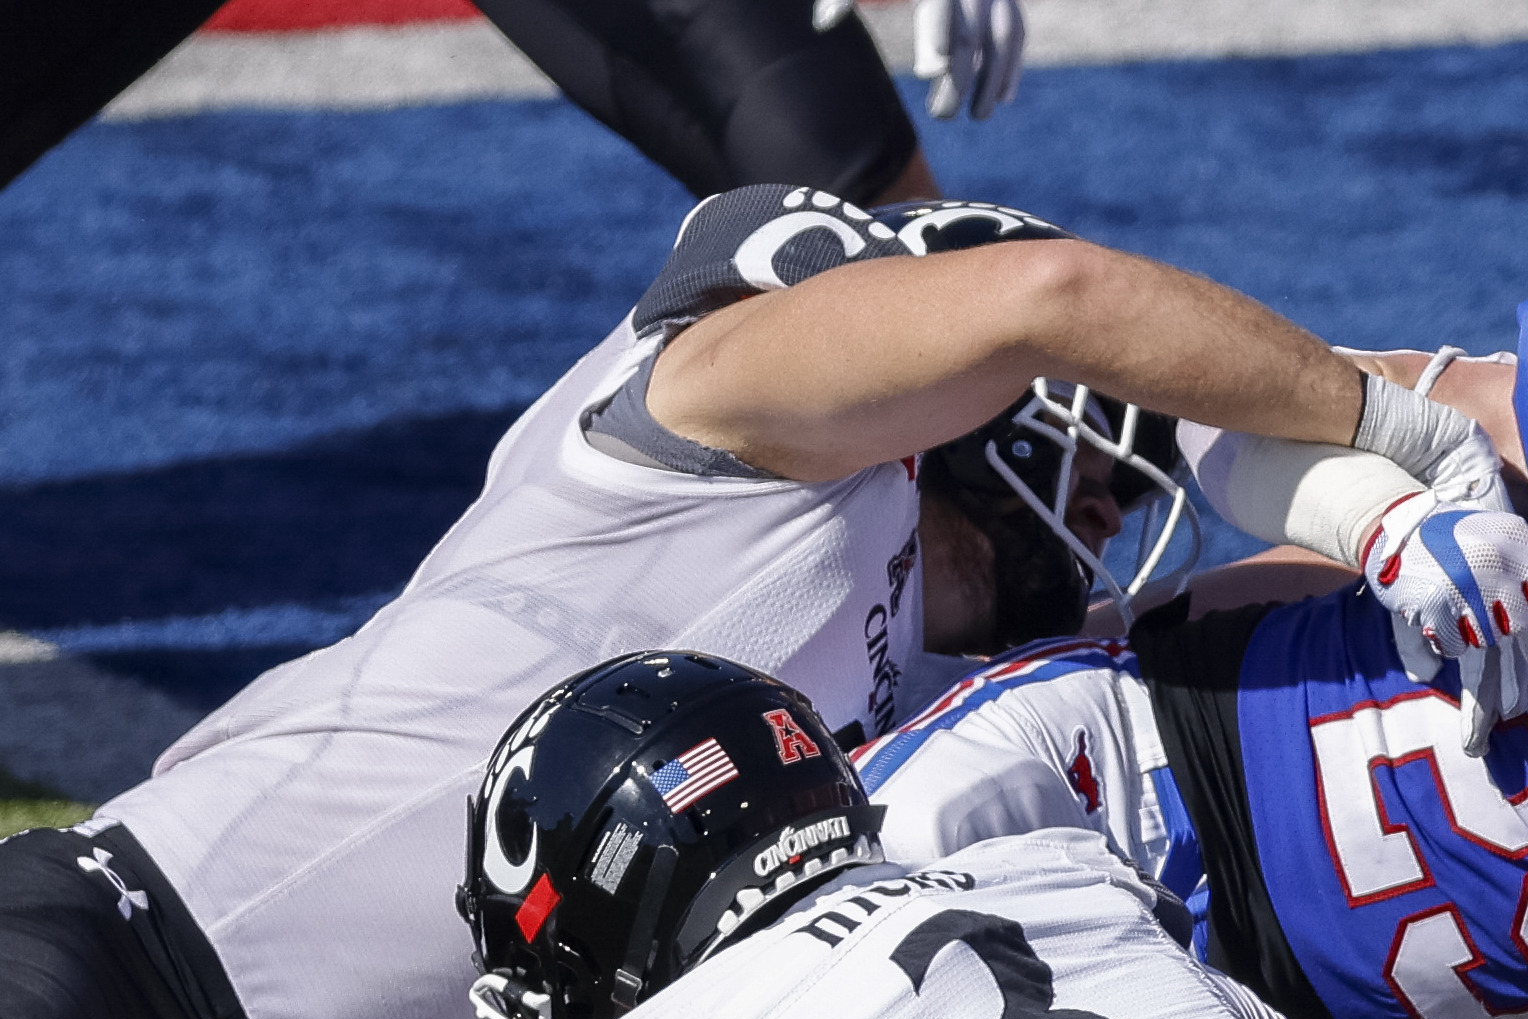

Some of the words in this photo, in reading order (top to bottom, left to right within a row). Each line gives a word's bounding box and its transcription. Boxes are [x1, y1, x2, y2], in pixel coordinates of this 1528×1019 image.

[865, 603, 896, 736] CINCIN
[762, 708, 821, 765] A
[754, 815, 850, 877] CINCINNATI
